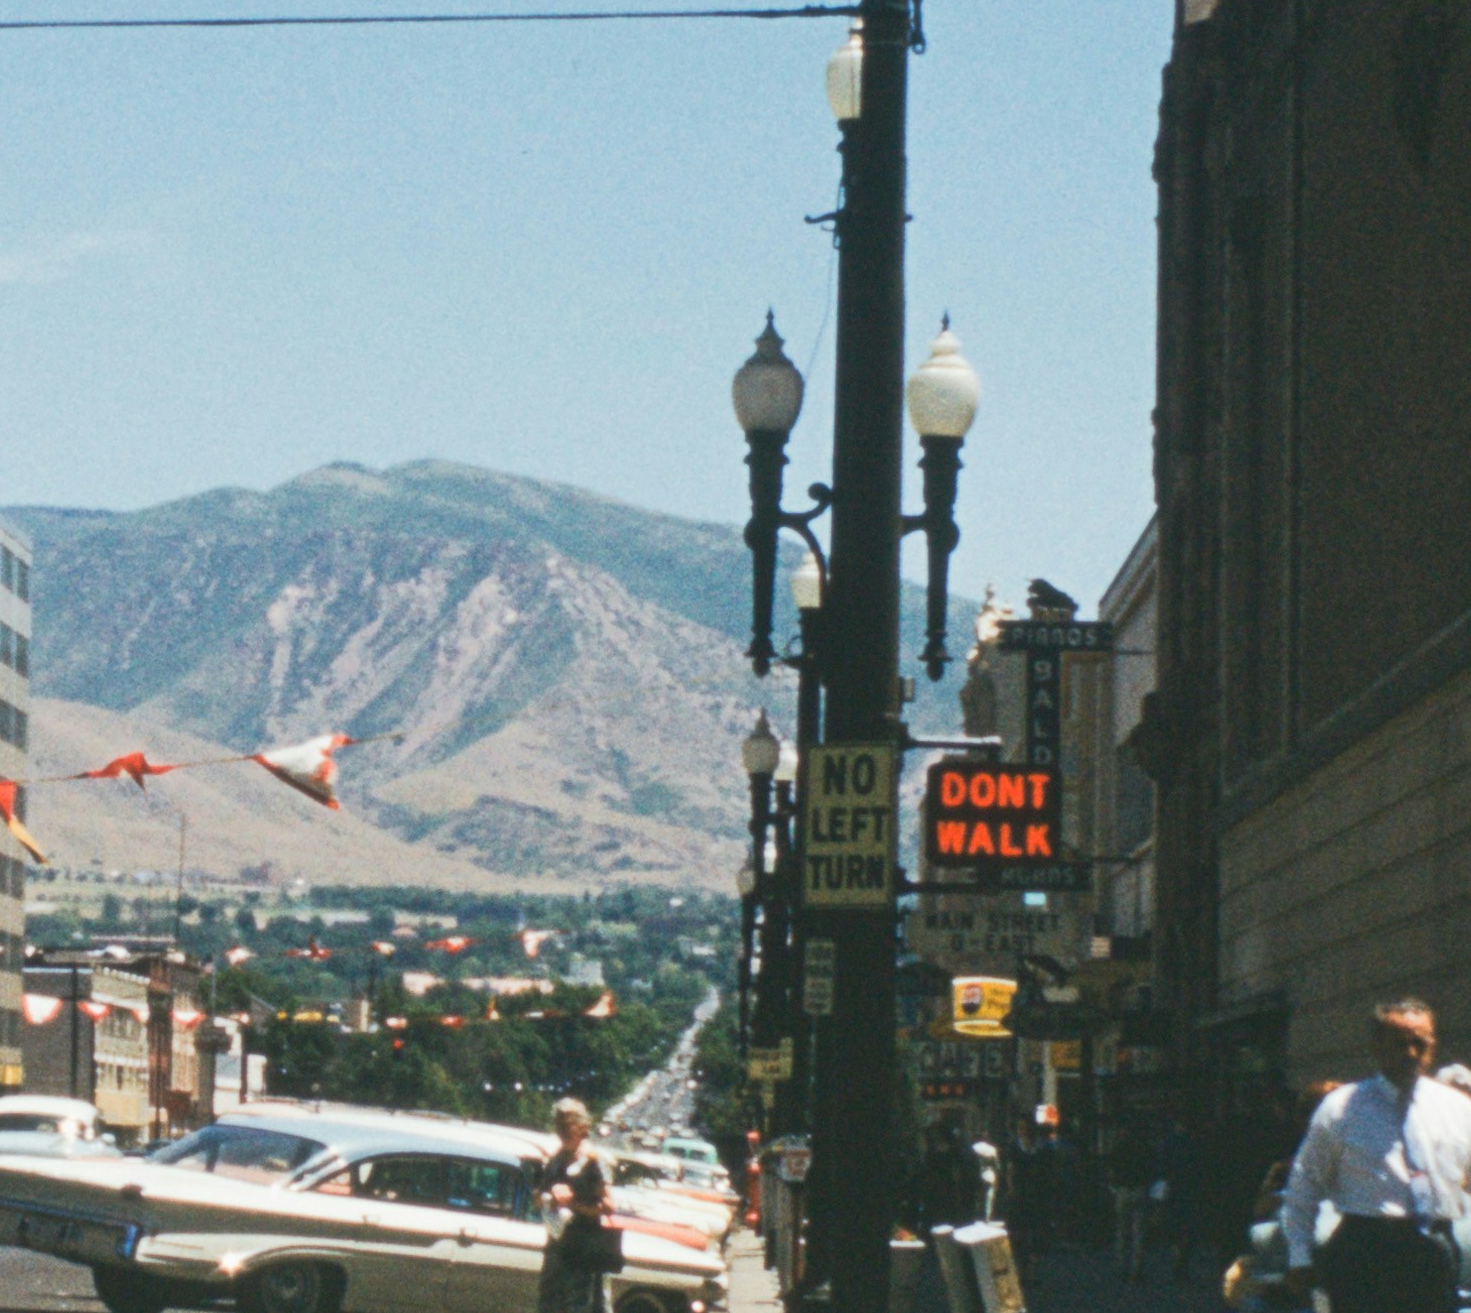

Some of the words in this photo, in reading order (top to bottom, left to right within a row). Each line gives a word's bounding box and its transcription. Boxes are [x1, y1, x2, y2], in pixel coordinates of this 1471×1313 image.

[824, 753, 875, 796] NO
[940, 770, 1051, 810] DONT
[811, 807, 890, 843] LEFT
[936, 819, 1052, 858] WALK
[808, 854, 885, 890] TURN
